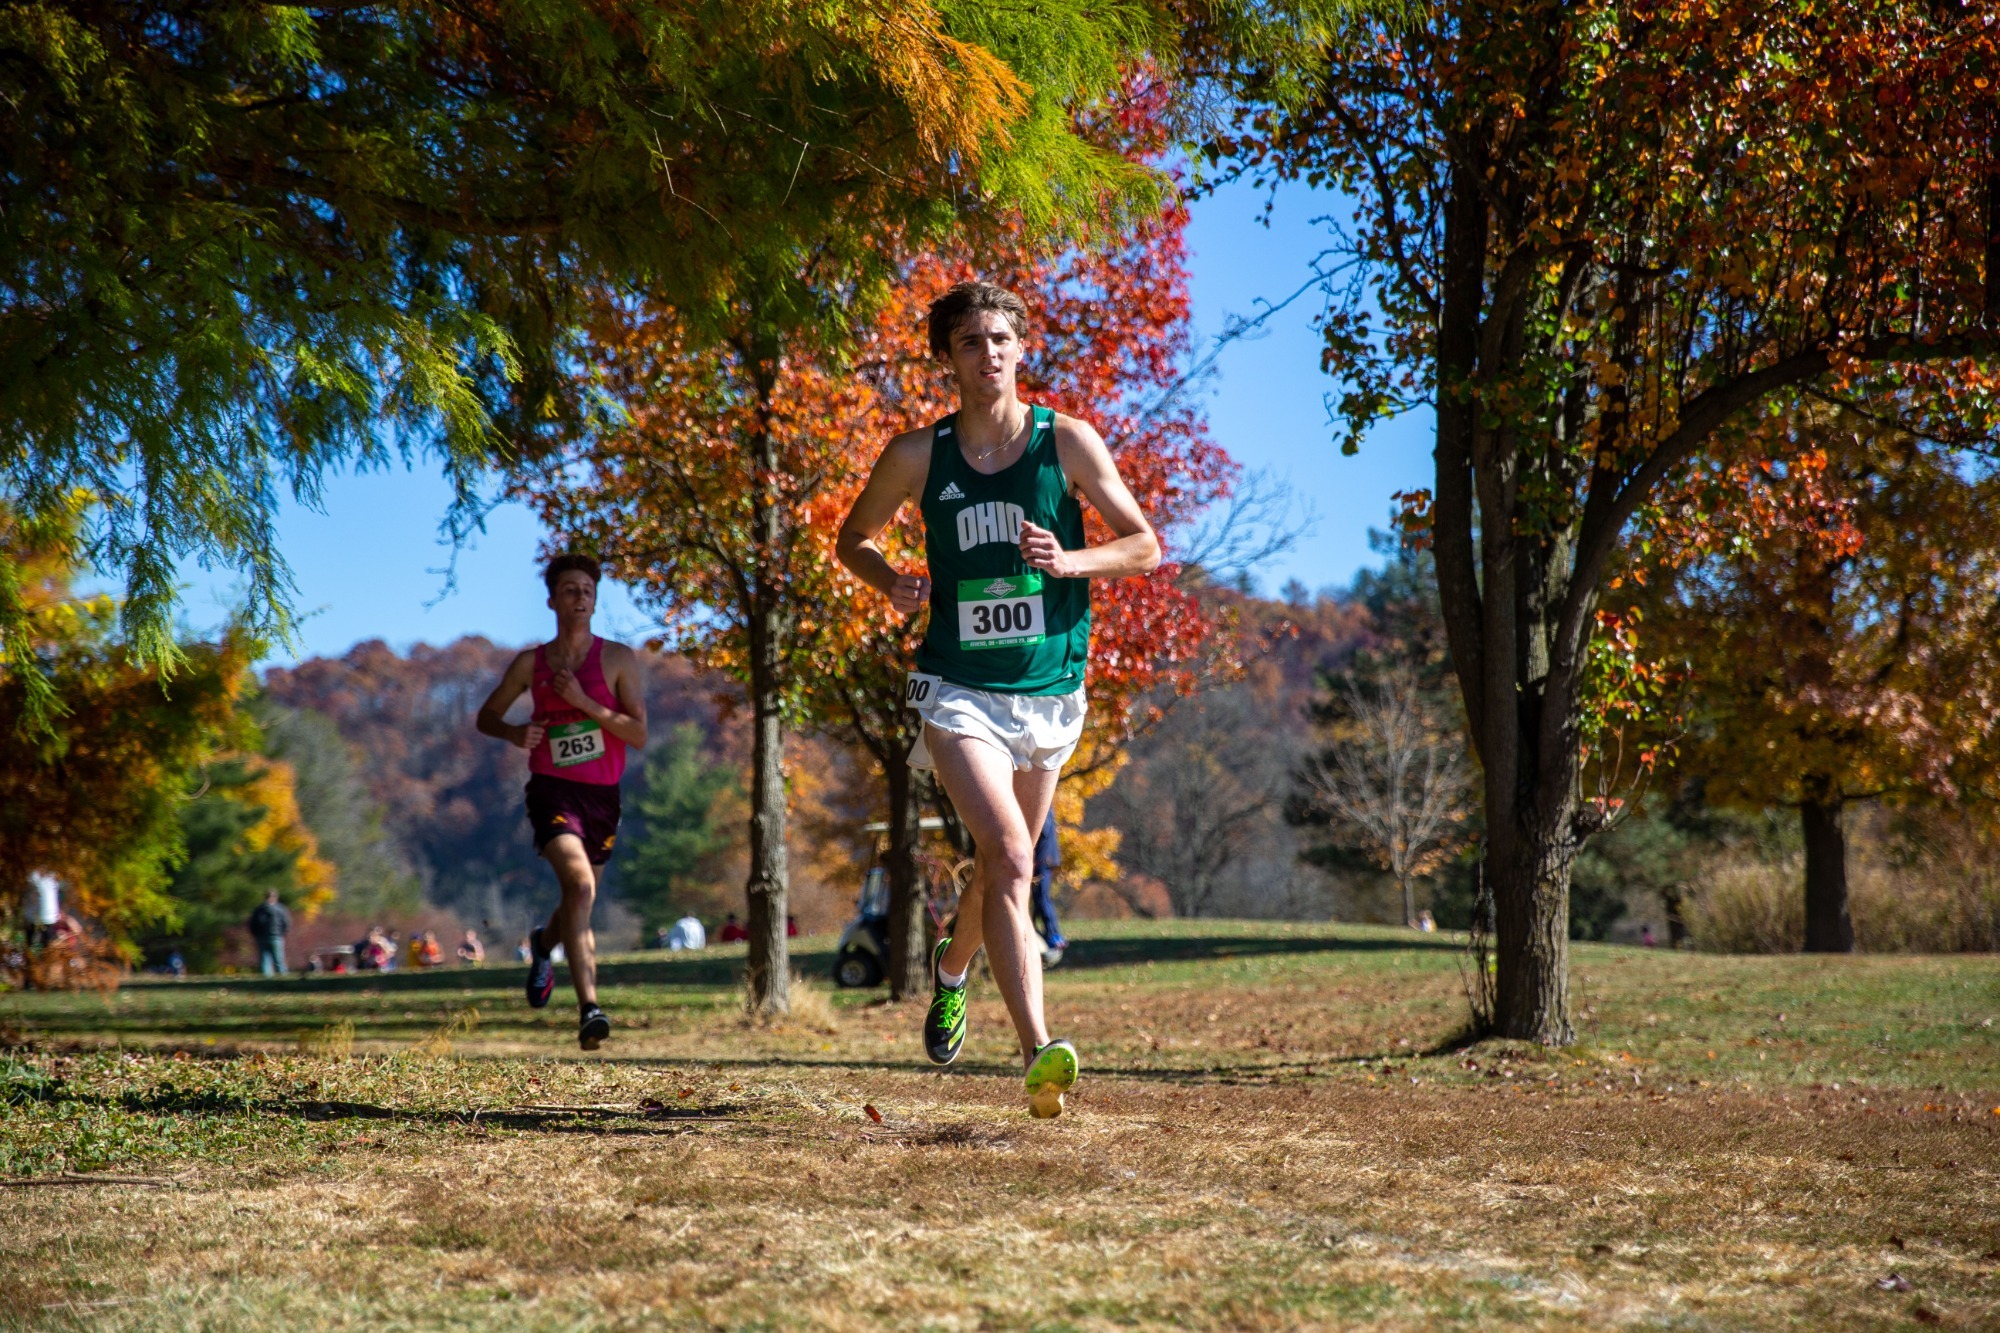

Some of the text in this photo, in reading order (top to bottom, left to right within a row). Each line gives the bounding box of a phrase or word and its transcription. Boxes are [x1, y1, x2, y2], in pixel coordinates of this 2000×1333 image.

[938, 491, 966, 501] adidas
[956, 501, 1025, 552] OHIO
[972, 602, 1032, 635] 300
[559, 736, 595, 758] 263
